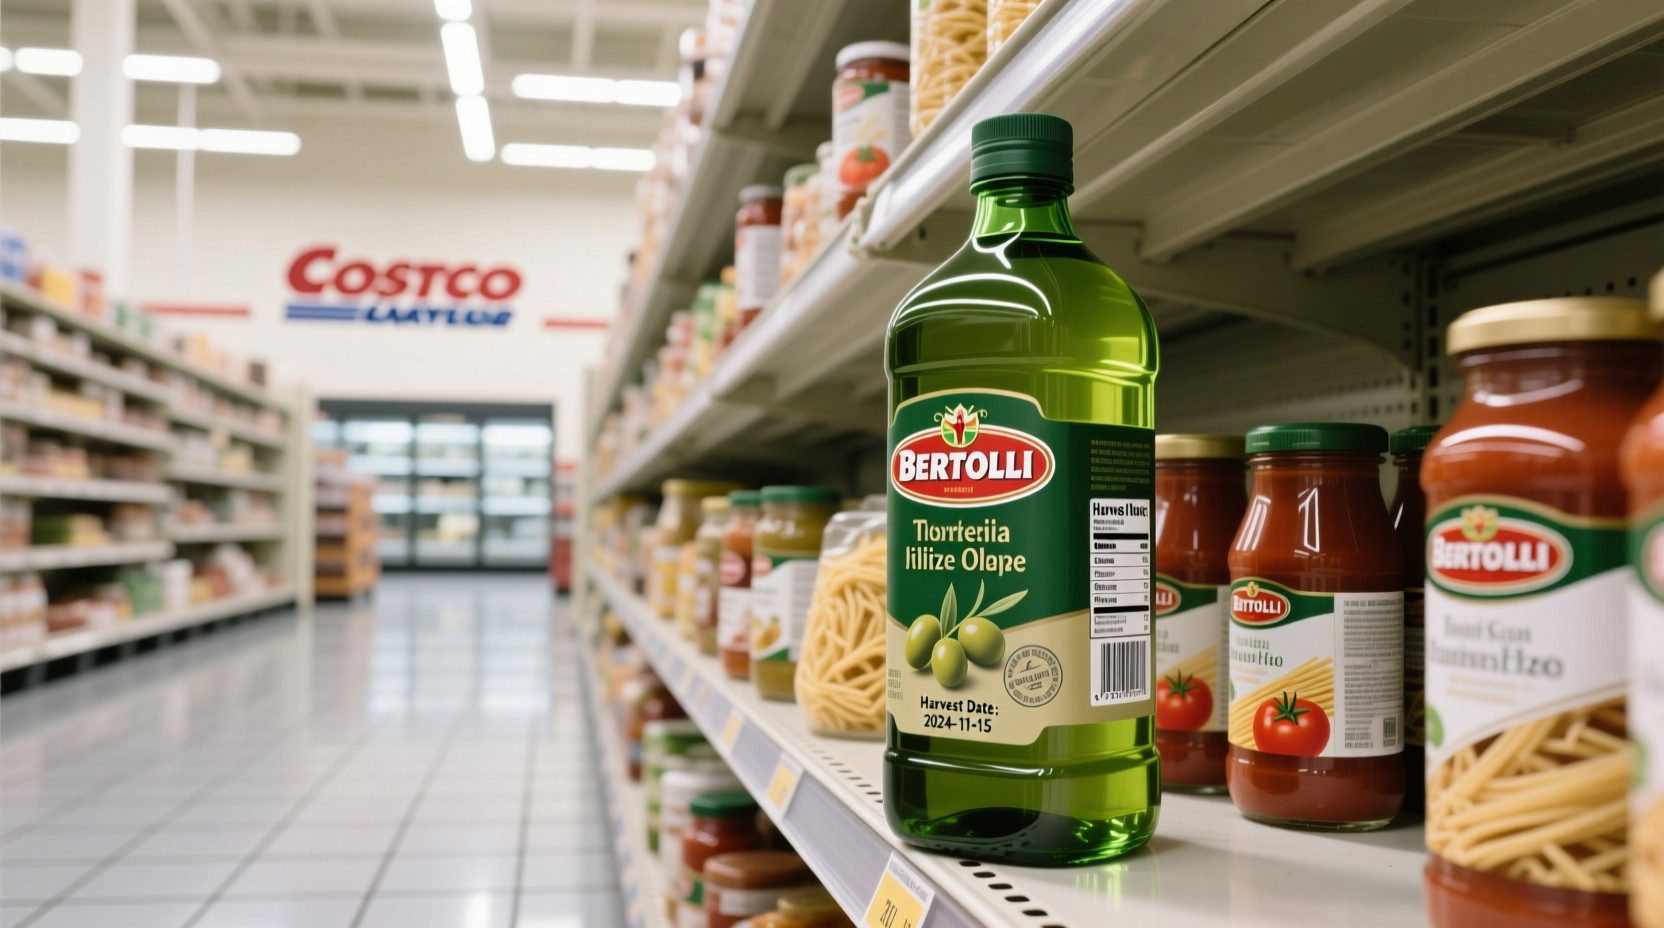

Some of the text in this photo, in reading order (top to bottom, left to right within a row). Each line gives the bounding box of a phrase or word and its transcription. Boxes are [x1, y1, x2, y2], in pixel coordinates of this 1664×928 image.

[286, 247, 523, 301] COSTCO
[898, 449, 1034, 482] BERTOLLI
[1432, 536, 1550, 572] BERTOLLI
[920, 695, 999, 717] Harvest Date:
[923, 713, 992, 733] 2024-11-15
